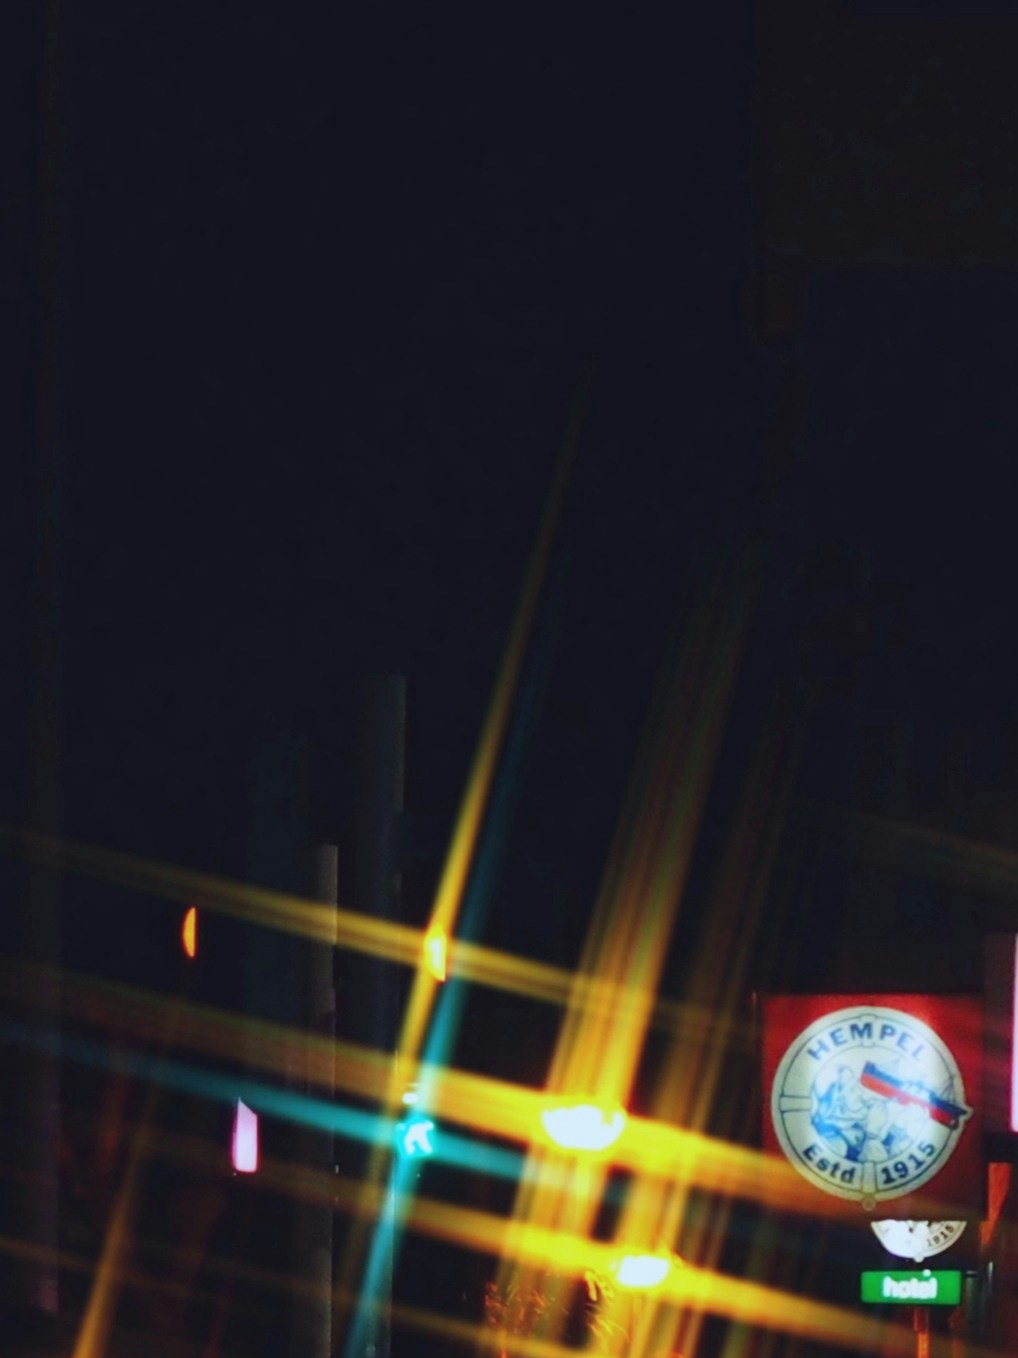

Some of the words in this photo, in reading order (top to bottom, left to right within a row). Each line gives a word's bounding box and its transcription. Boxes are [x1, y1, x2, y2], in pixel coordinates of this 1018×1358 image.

[806, 1022, 928, 1061] HEMPEL
[801, 1144, 854, 1184] Estd
[882, 1141, 938, 1186] 1915
